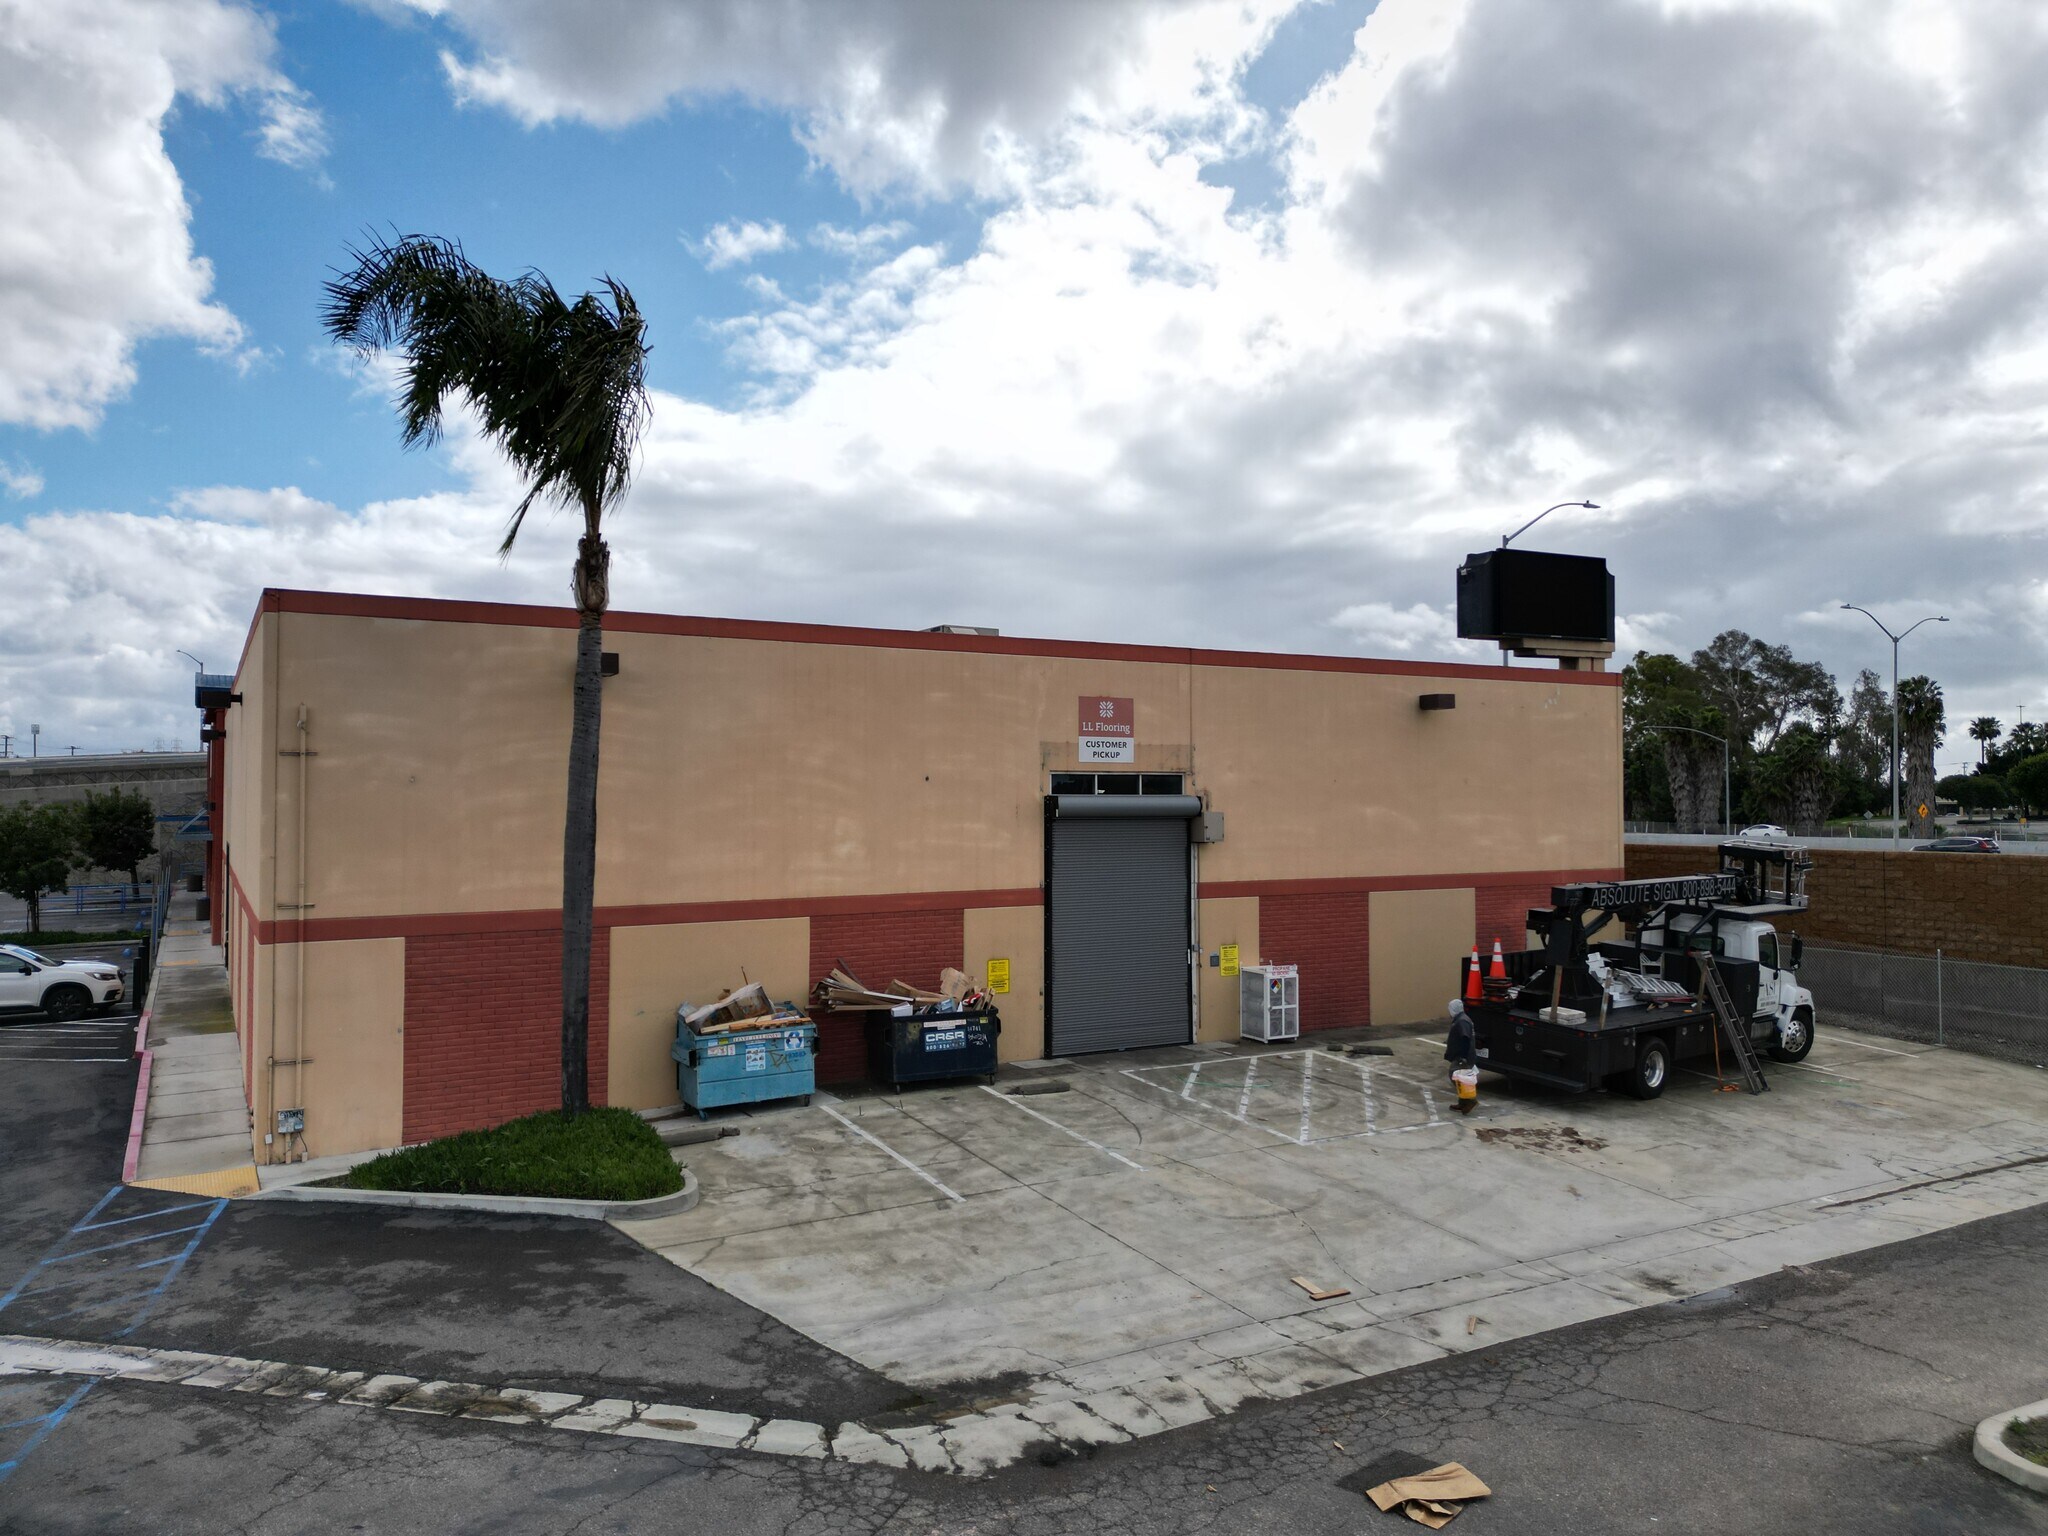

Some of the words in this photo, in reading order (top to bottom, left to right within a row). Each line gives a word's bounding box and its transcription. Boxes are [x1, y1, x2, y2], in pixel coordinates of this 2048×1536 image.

[1082, 722, 1094, 731] LL
[1096, 722, 1130, 734] Flooring
[1592, 885, 1650, 906] ABSOLUTE
[1653, 882, 1679, 901] SIGN
[926, 1031, 964, 1041] CR&R
